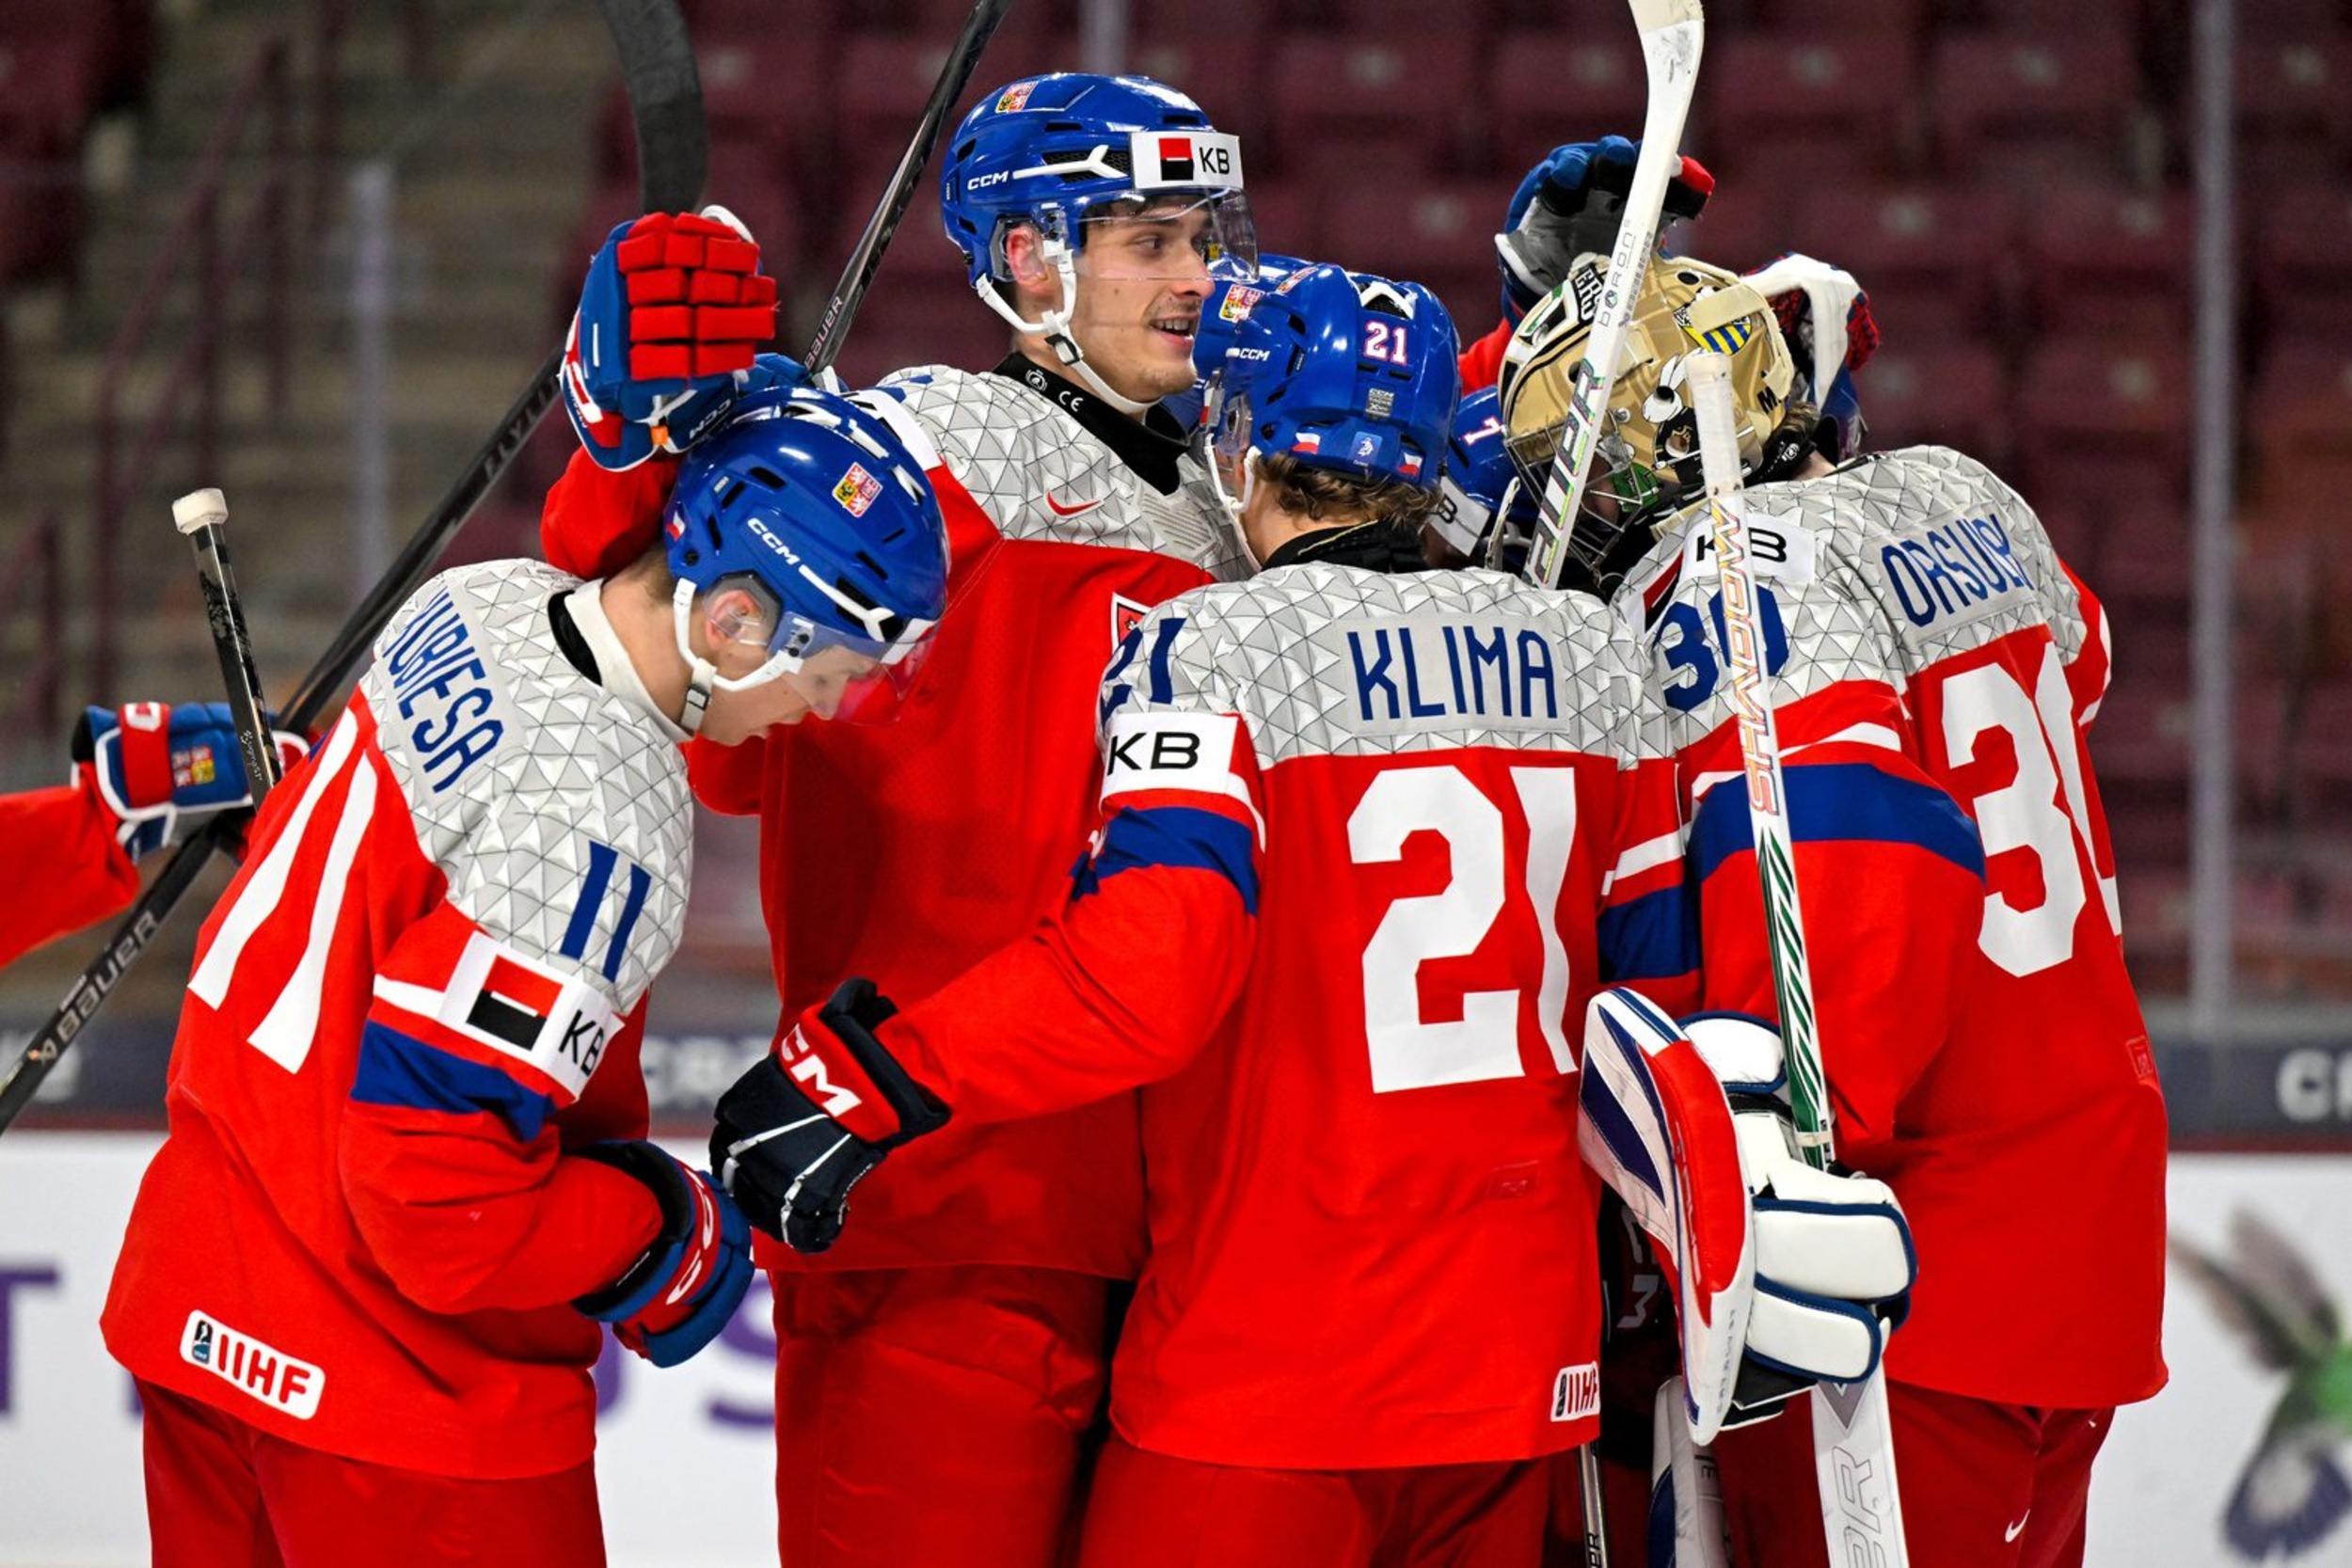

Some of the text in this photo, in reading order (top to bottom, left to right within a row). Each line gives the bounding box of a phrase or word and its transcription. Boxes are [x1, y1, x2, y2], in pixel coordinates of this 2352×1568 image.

[967, 171, 1009, 190] CCM
[1200, 147, 1230, 174] KB
[804, 295, 844, 372] BAUER
[1239, 348, 1270, 361] CCM
[1364, 322, 1407, 366] 21
[747, 517, 801, 565] CCM
[1347, 626, 1558, 721] KLIMA
[1106, 732, 1200, 775] KB
[187, 707, 377, 1074] 11
[560, 840, 651, 984] 11
[1346, 765, 1580, 1093] 21
[56, 911, 158, 1044] BAUER
[558, 1009, 604, 1077] KB
[217, 1334, 311, 1404] IIHF
